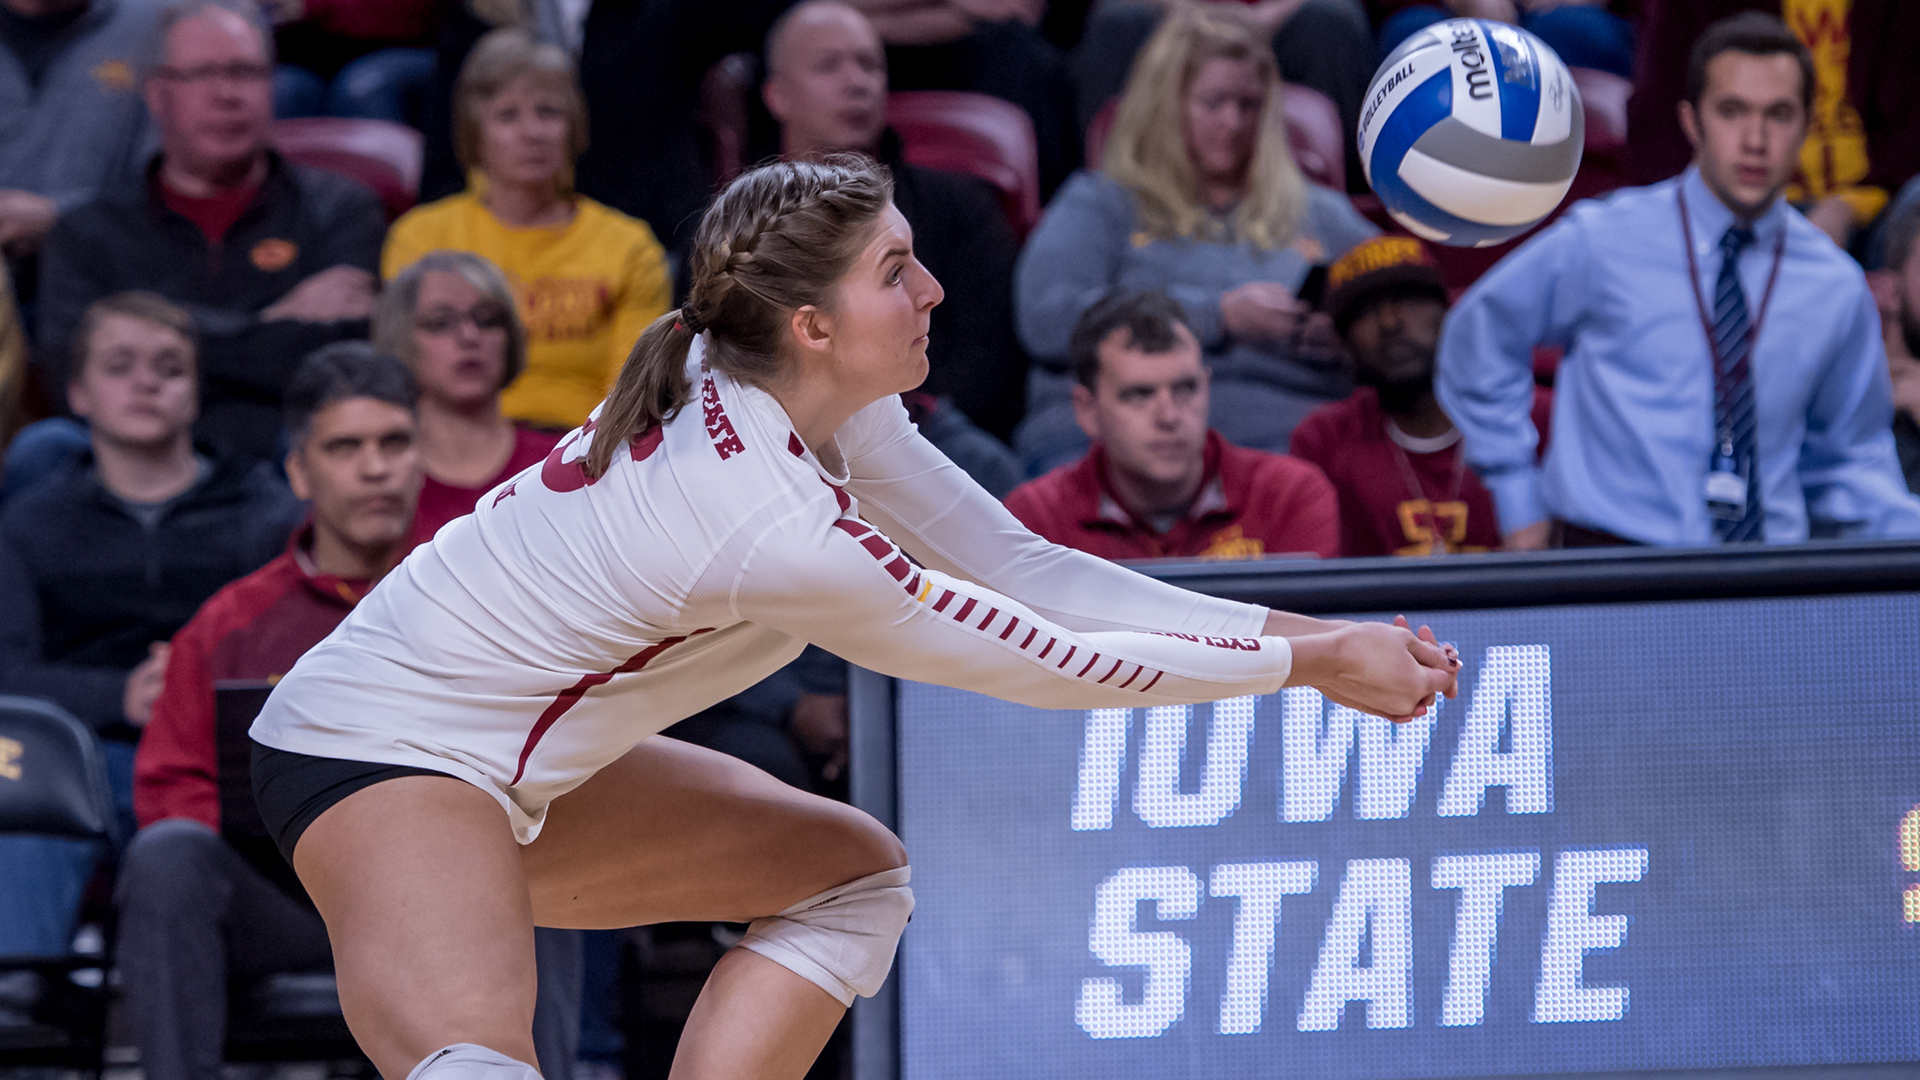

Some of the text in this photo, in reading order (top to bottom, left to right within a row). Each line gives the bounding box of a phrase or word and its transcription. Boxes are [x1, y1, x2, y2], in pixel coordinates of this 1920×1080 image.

[1362, 62, 1416, 132] VOLLEYBALL
[1071, 644, 1553, 830] IOWA
[1075, 848, 1649, 1039] STATE
